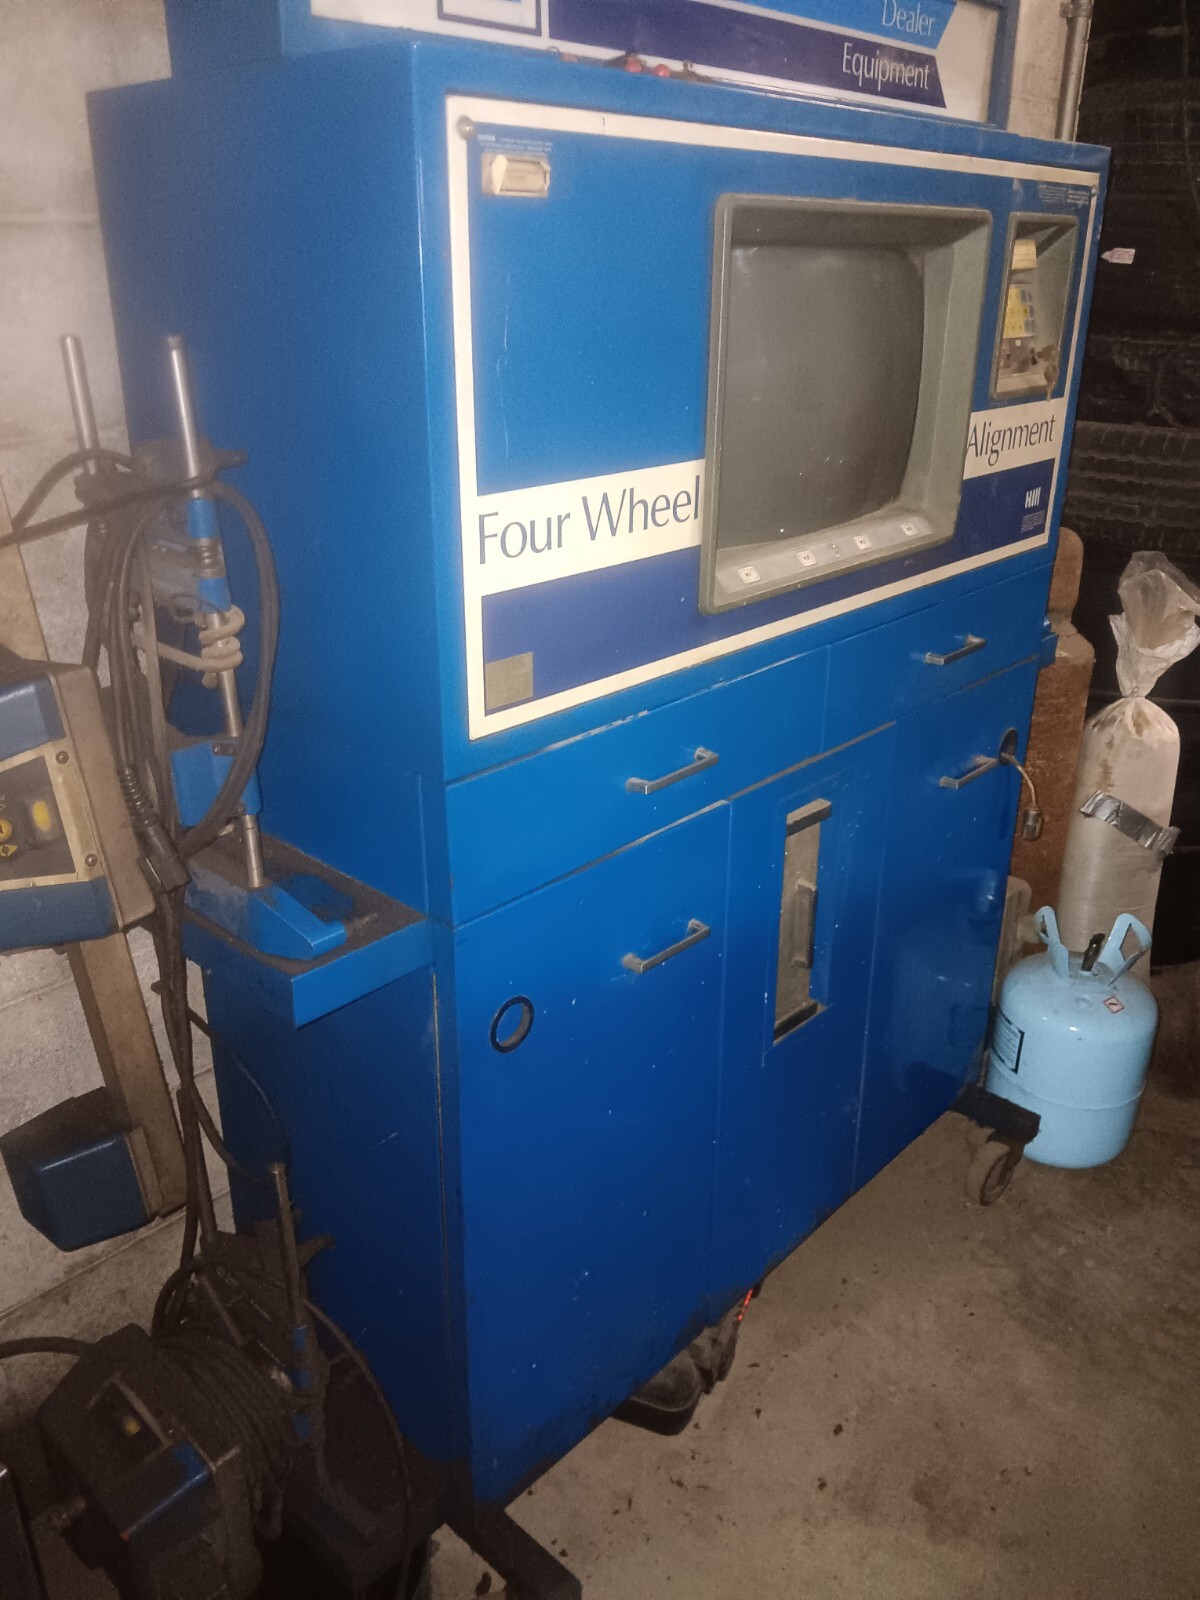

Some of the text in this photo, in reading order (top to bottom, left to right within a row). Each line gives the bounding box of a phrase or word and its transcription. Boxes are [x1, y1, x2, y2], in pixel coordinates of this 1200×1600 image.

[881, 0, 935, 36] Dealer
[842, 42, 929, 92] Equipment
[967, 414, 1056, 467] Alignment
[478, 475, 700, 565] Four Wheel
